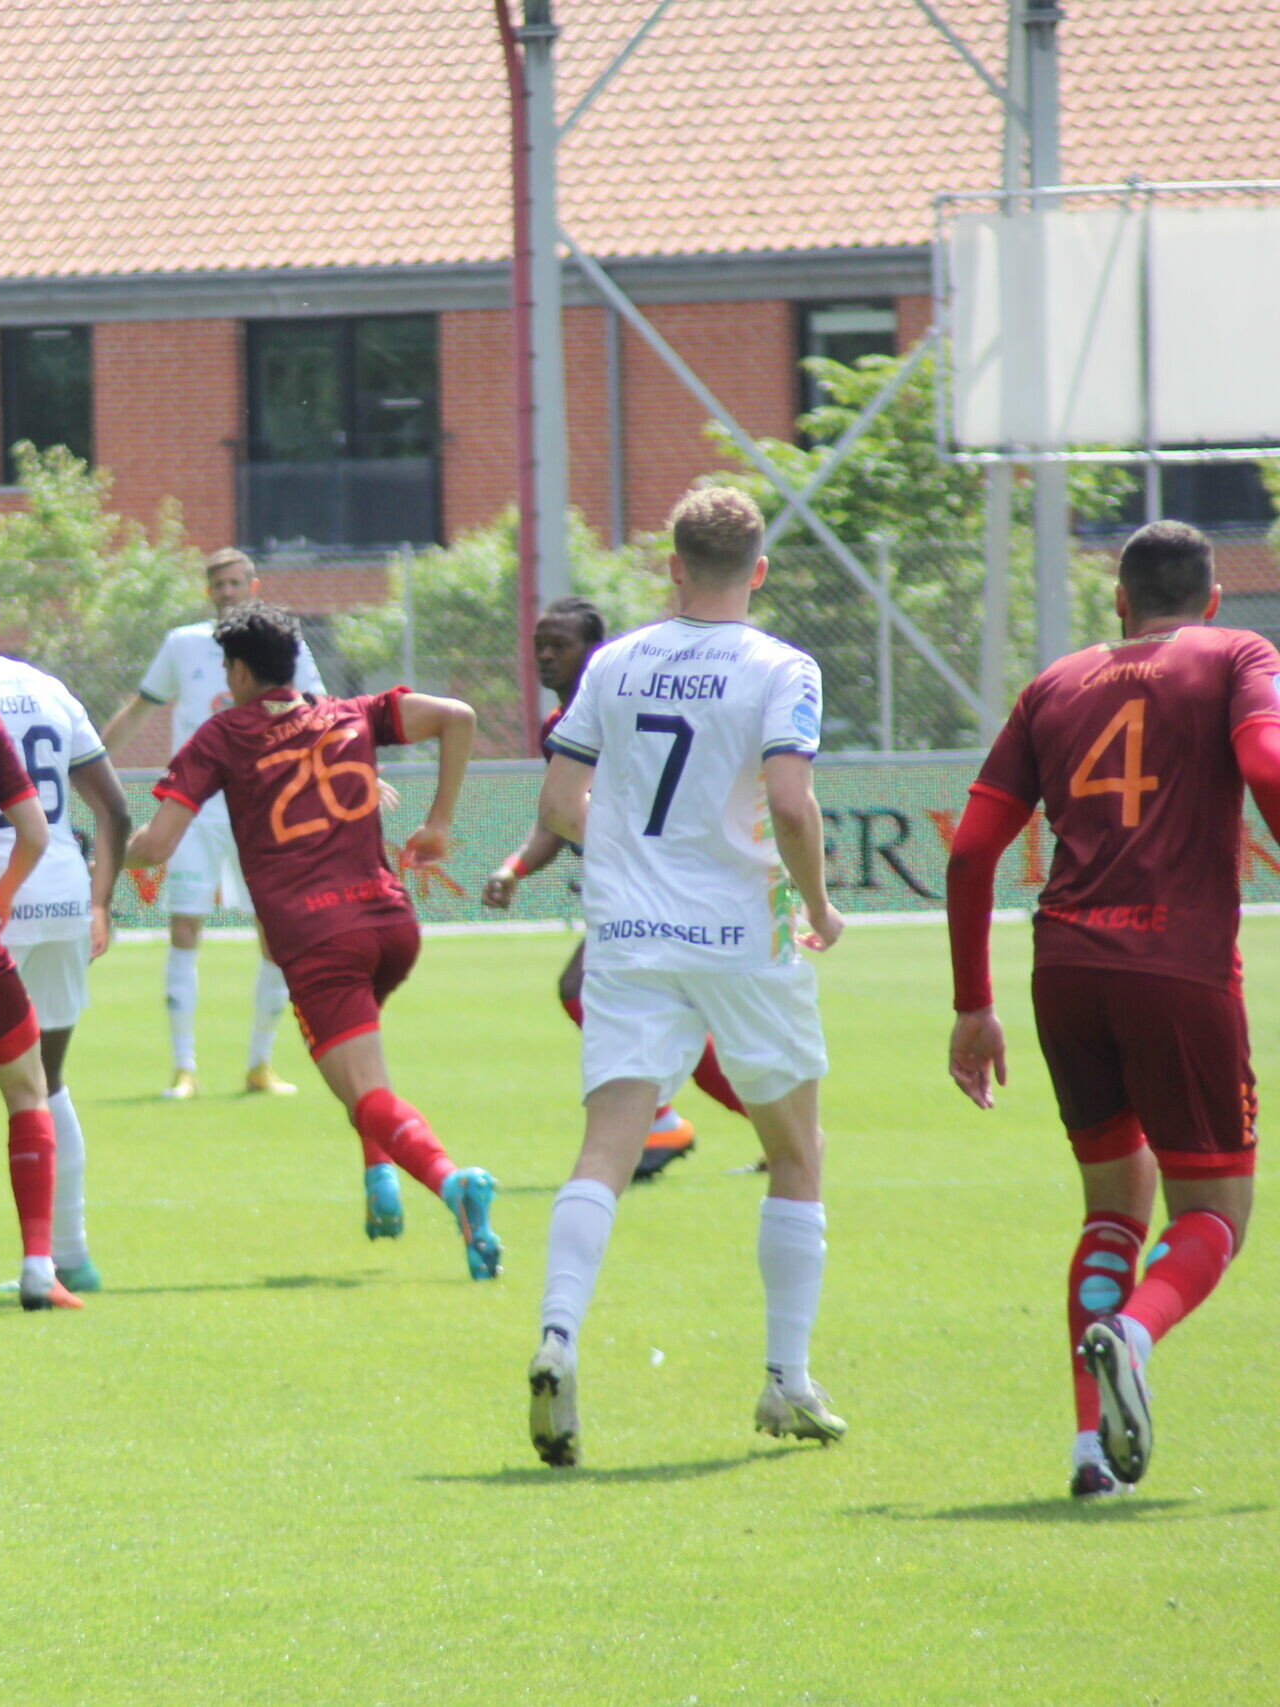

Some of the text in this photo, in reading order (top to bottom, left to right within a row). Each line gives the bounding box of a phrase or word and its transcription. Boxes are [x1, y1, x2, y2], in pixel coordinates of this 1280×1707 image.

[640, 643, 739, 663] Nordjyske Bank
[617, 672, 728, 700] L. JENSEN
[634, 712, 695, 837] 7
[1070, 698, 1159, 827] 4
[256, 728, 379, 843] 26
[11, 901, 83, 922] NDSYSSEL
[598, 919, 745, 945] VENDSYSSEL FF
